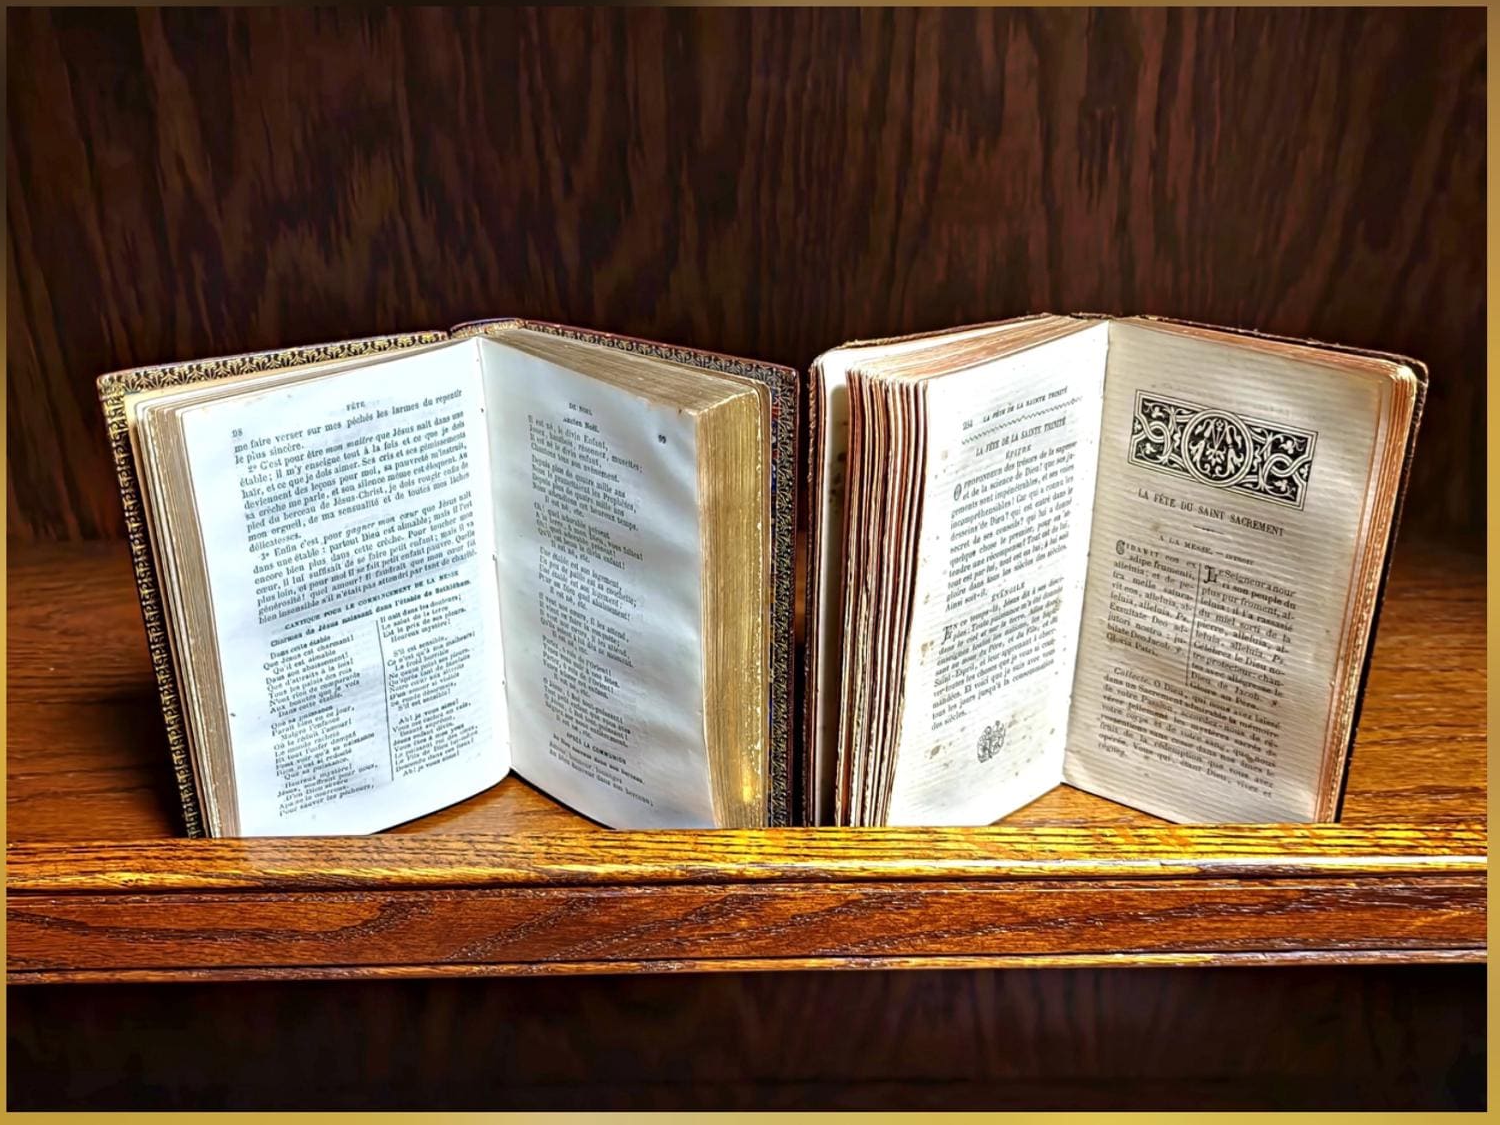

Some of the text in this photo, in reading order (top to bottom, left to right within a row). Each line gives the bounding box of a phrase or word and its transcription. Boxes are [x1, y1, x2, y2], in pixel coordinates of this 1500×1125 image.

[250, 437, 271, 450] faire
[275, 430, 302, 443] verser
[307, 427, 321, 436] sur
[325, 421, 341, 432] mes
[346, 413, 373, 428] péchés
[376, 410, 388, 419] les
[392, 402, 419, 415] larmes
[247, 451, 267, 462] plus
[1138, 488, 1149, 500] LA
[1181, 501, 1193, 512] DU
[1198, 506, 1225, 519] SAINT
[1230, 513, 1284, 537] SACREMENT
